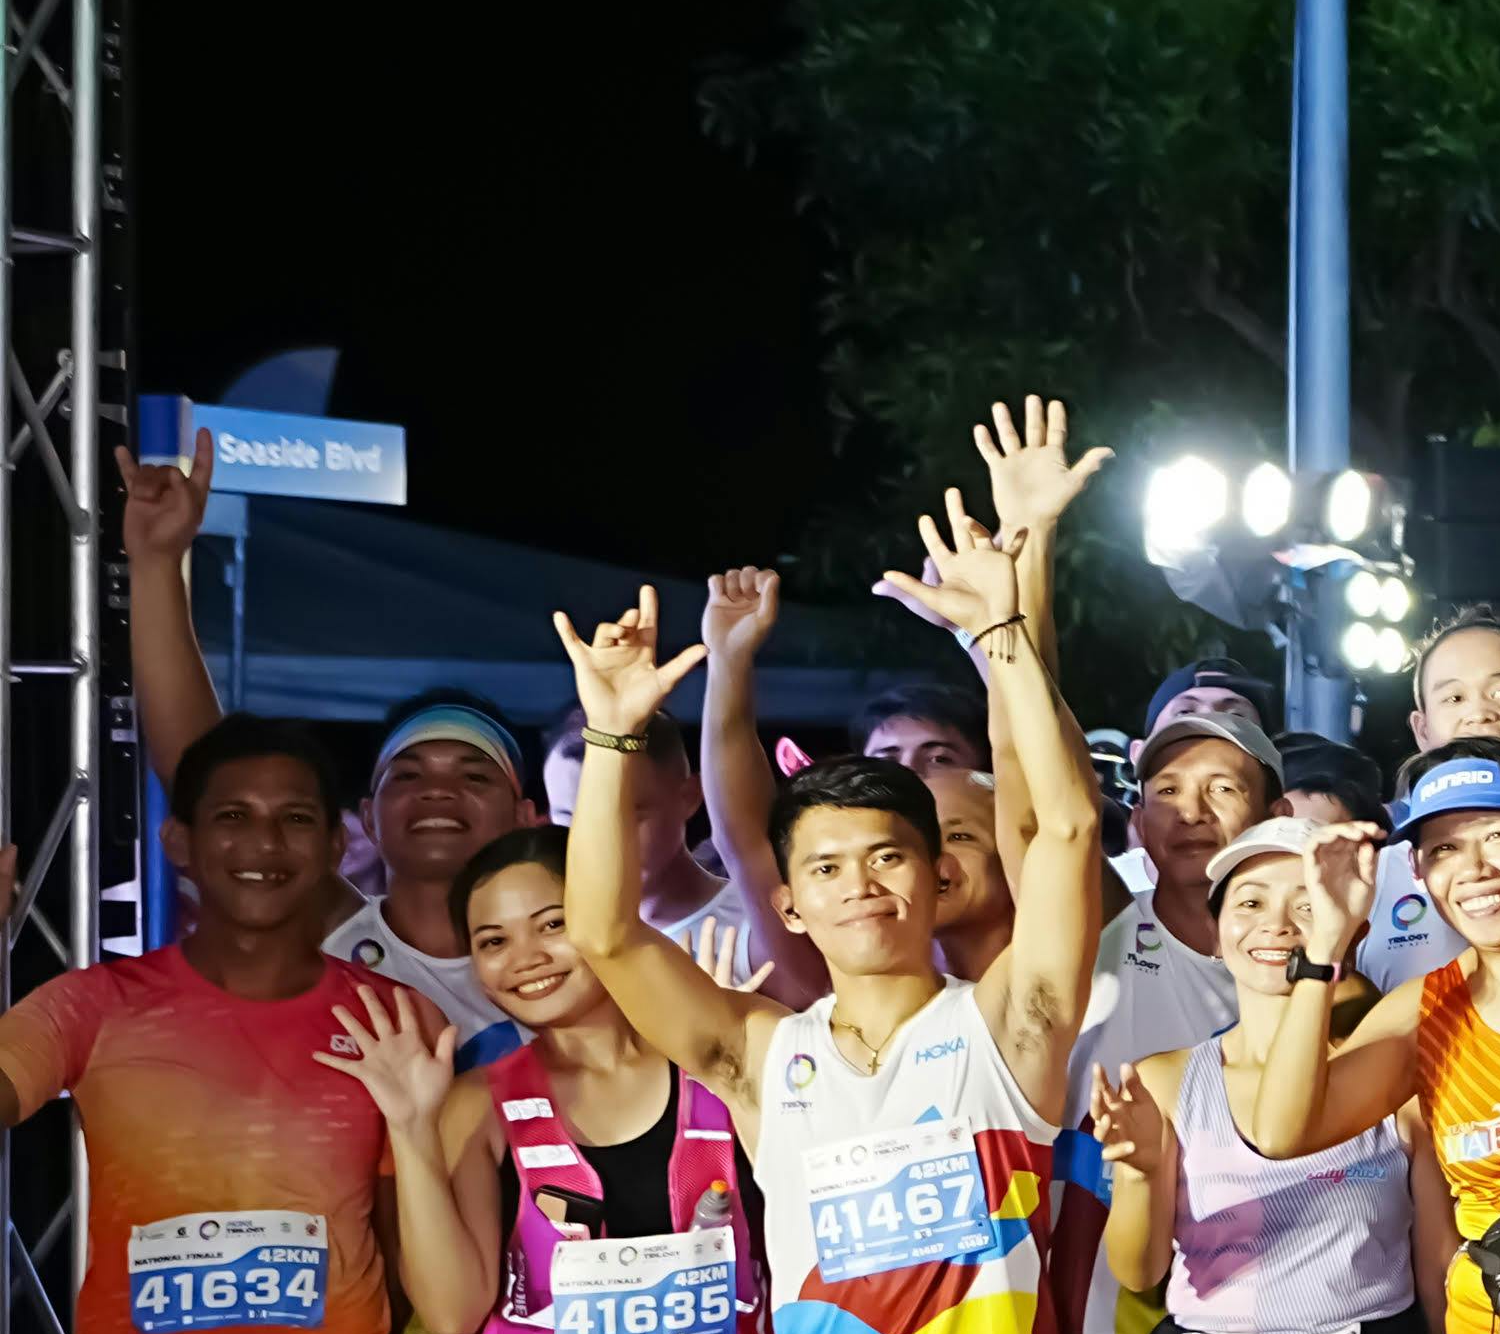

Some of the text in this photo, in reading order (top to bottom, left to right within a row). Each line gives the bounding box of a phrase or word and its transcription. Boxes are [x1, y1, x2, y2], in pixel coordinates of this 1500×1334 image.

[218, 432, 382, 473] Seaside Blvd
[916, 1036, 965, 1064] HOKA
[909, 1155, 970, 1180] 42KM
[816, 1175, 975, 1244] 41467
[258, 1249, 320, 1264] 42KM
[674, 1265, 728, 1287] 42KM
[136, 1268, 319, 1314] 41634
